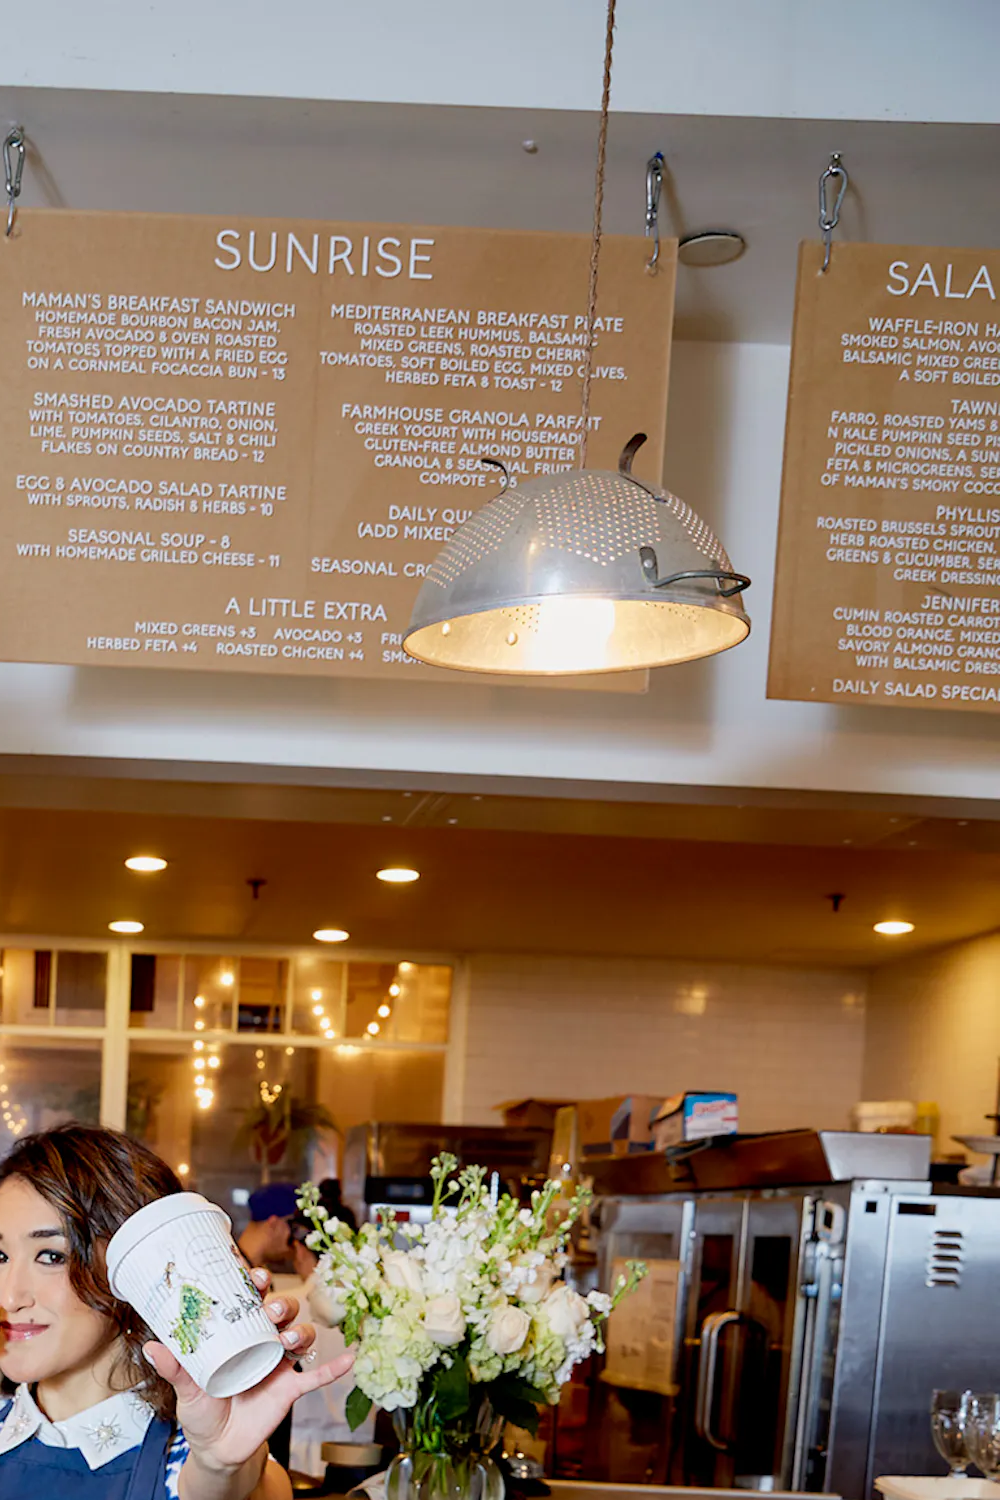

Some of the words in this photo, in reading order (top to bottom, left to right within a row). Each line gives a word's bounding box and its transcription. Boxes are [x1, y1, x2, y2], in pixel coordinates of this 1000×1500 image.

[213, 229, 435, 280] SUNRISE
[21, 291, 102, 310] MAMAN'S
[107, 294, 201, 314] BREAKFAST
[204, 298, 296, 318] SANDWICH
[34, 309, 116, 326] HOMEMADE
[121, 313, 188, 329] BOURBON
[193, 316, 242, 331] BACON
[330, 303, 471, 325] MEDITERRANEAN
[476, 309, 570, 330] BREAKFAST
[868, 316, 980, 337] WAFFLE-IRON
[840, 333, 899, 349] SMOKED
[898, 368, 911, 382] A
[913, 368, 949, 384] SOFT
[33, 391, 114, 410] SMASHED
[117, 395, 202, 414] AVOCADO
[206, 398, 276, 417] TARTINE
[341, 402, 444, 423] FARMHOUSE
[448, 408, 530, 428] GRANOLA
[883, 413, 945, 429] ROASTED
[948, 416, 986, 431] YAMS
[363, 437, 457, 454] GLUTEN-FREE
[459, 442, 522, 458] ALMOND
[525, 445, 575, 461] BUTTER
[15, 474, 51, 491] EGG
[69, 476, 153, 495] AVOCADO
[157, 480, 213, 498] SALAD
[217, 482, 287, 501] TARTINE
[388, 503, 438, 522] DAILY
[67, 527, 156, 547] SEASONAL
[159, 531, 206, 548] SOUP
[357, 522, 399, 539] (ADD
[829, 532, 865, 547] HERB
[869, 535, 930, 550] ROASTED
[15, 542, 51, 557] WITH
[55, 544, 137, 562] HOMEMADE
[139, 548, 199, 565] GRILLED
[201, 550, 256, 567] CHEESE
[310, 556, 399, 577] SEASONAL
[892, 567, 937, 583] GREEK
[224, 596, 241, 615] A
[248, 597, 317, 619] LITTLE
[323, 600, 388, 623] EXTRA
[832, 606, 881, 622] CUMIN
[883, 609, 945, 626] ROASTED
[134, 620, 179, 636] MIXED
[181, 622, 237, 638] GREENS
[272, 627, 343, 643] AVOCADO
[86, 636, 141, 651] HERBED
[144, 638, 179, 653] FETA
[215, 641, 279, 657] ROASTED
[280, 644, 345, 661] CHICKEN
[832, 678, 881, 695] DAILY
[883, 680, 938, 699] SALAD
[942, 682, 1000, 702] SPECIA
